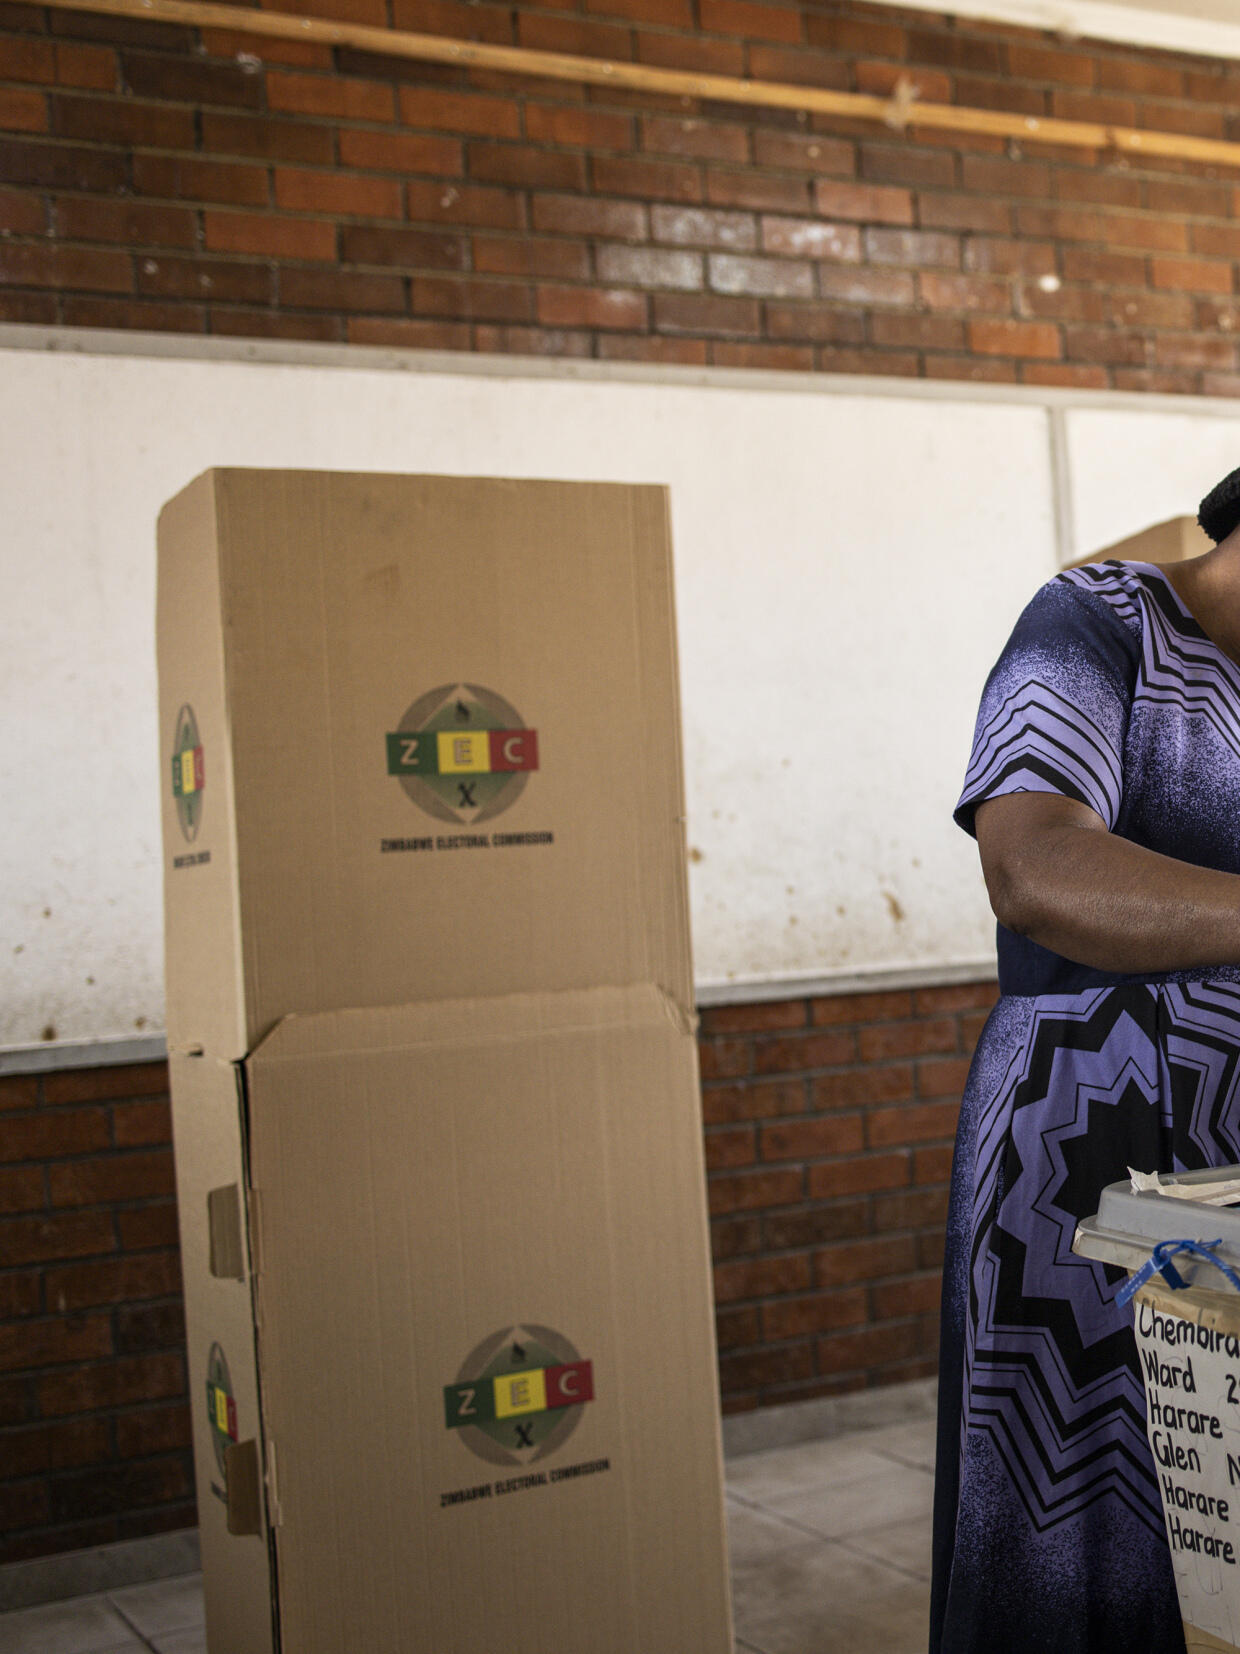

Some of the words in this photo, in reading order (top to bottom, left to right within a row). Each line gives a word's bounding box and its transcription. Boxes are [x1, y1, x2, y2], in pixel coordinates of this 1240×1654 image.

[1142, 1348, 1197, 1393] Ward
[1149, 1387, 1223, 1439] Harare
[1152, 1431, 1202, 1473] Glen
[1161, 1474, 1229, 1521] Harare
[1168, 1512, 1236, 1564] Harare
